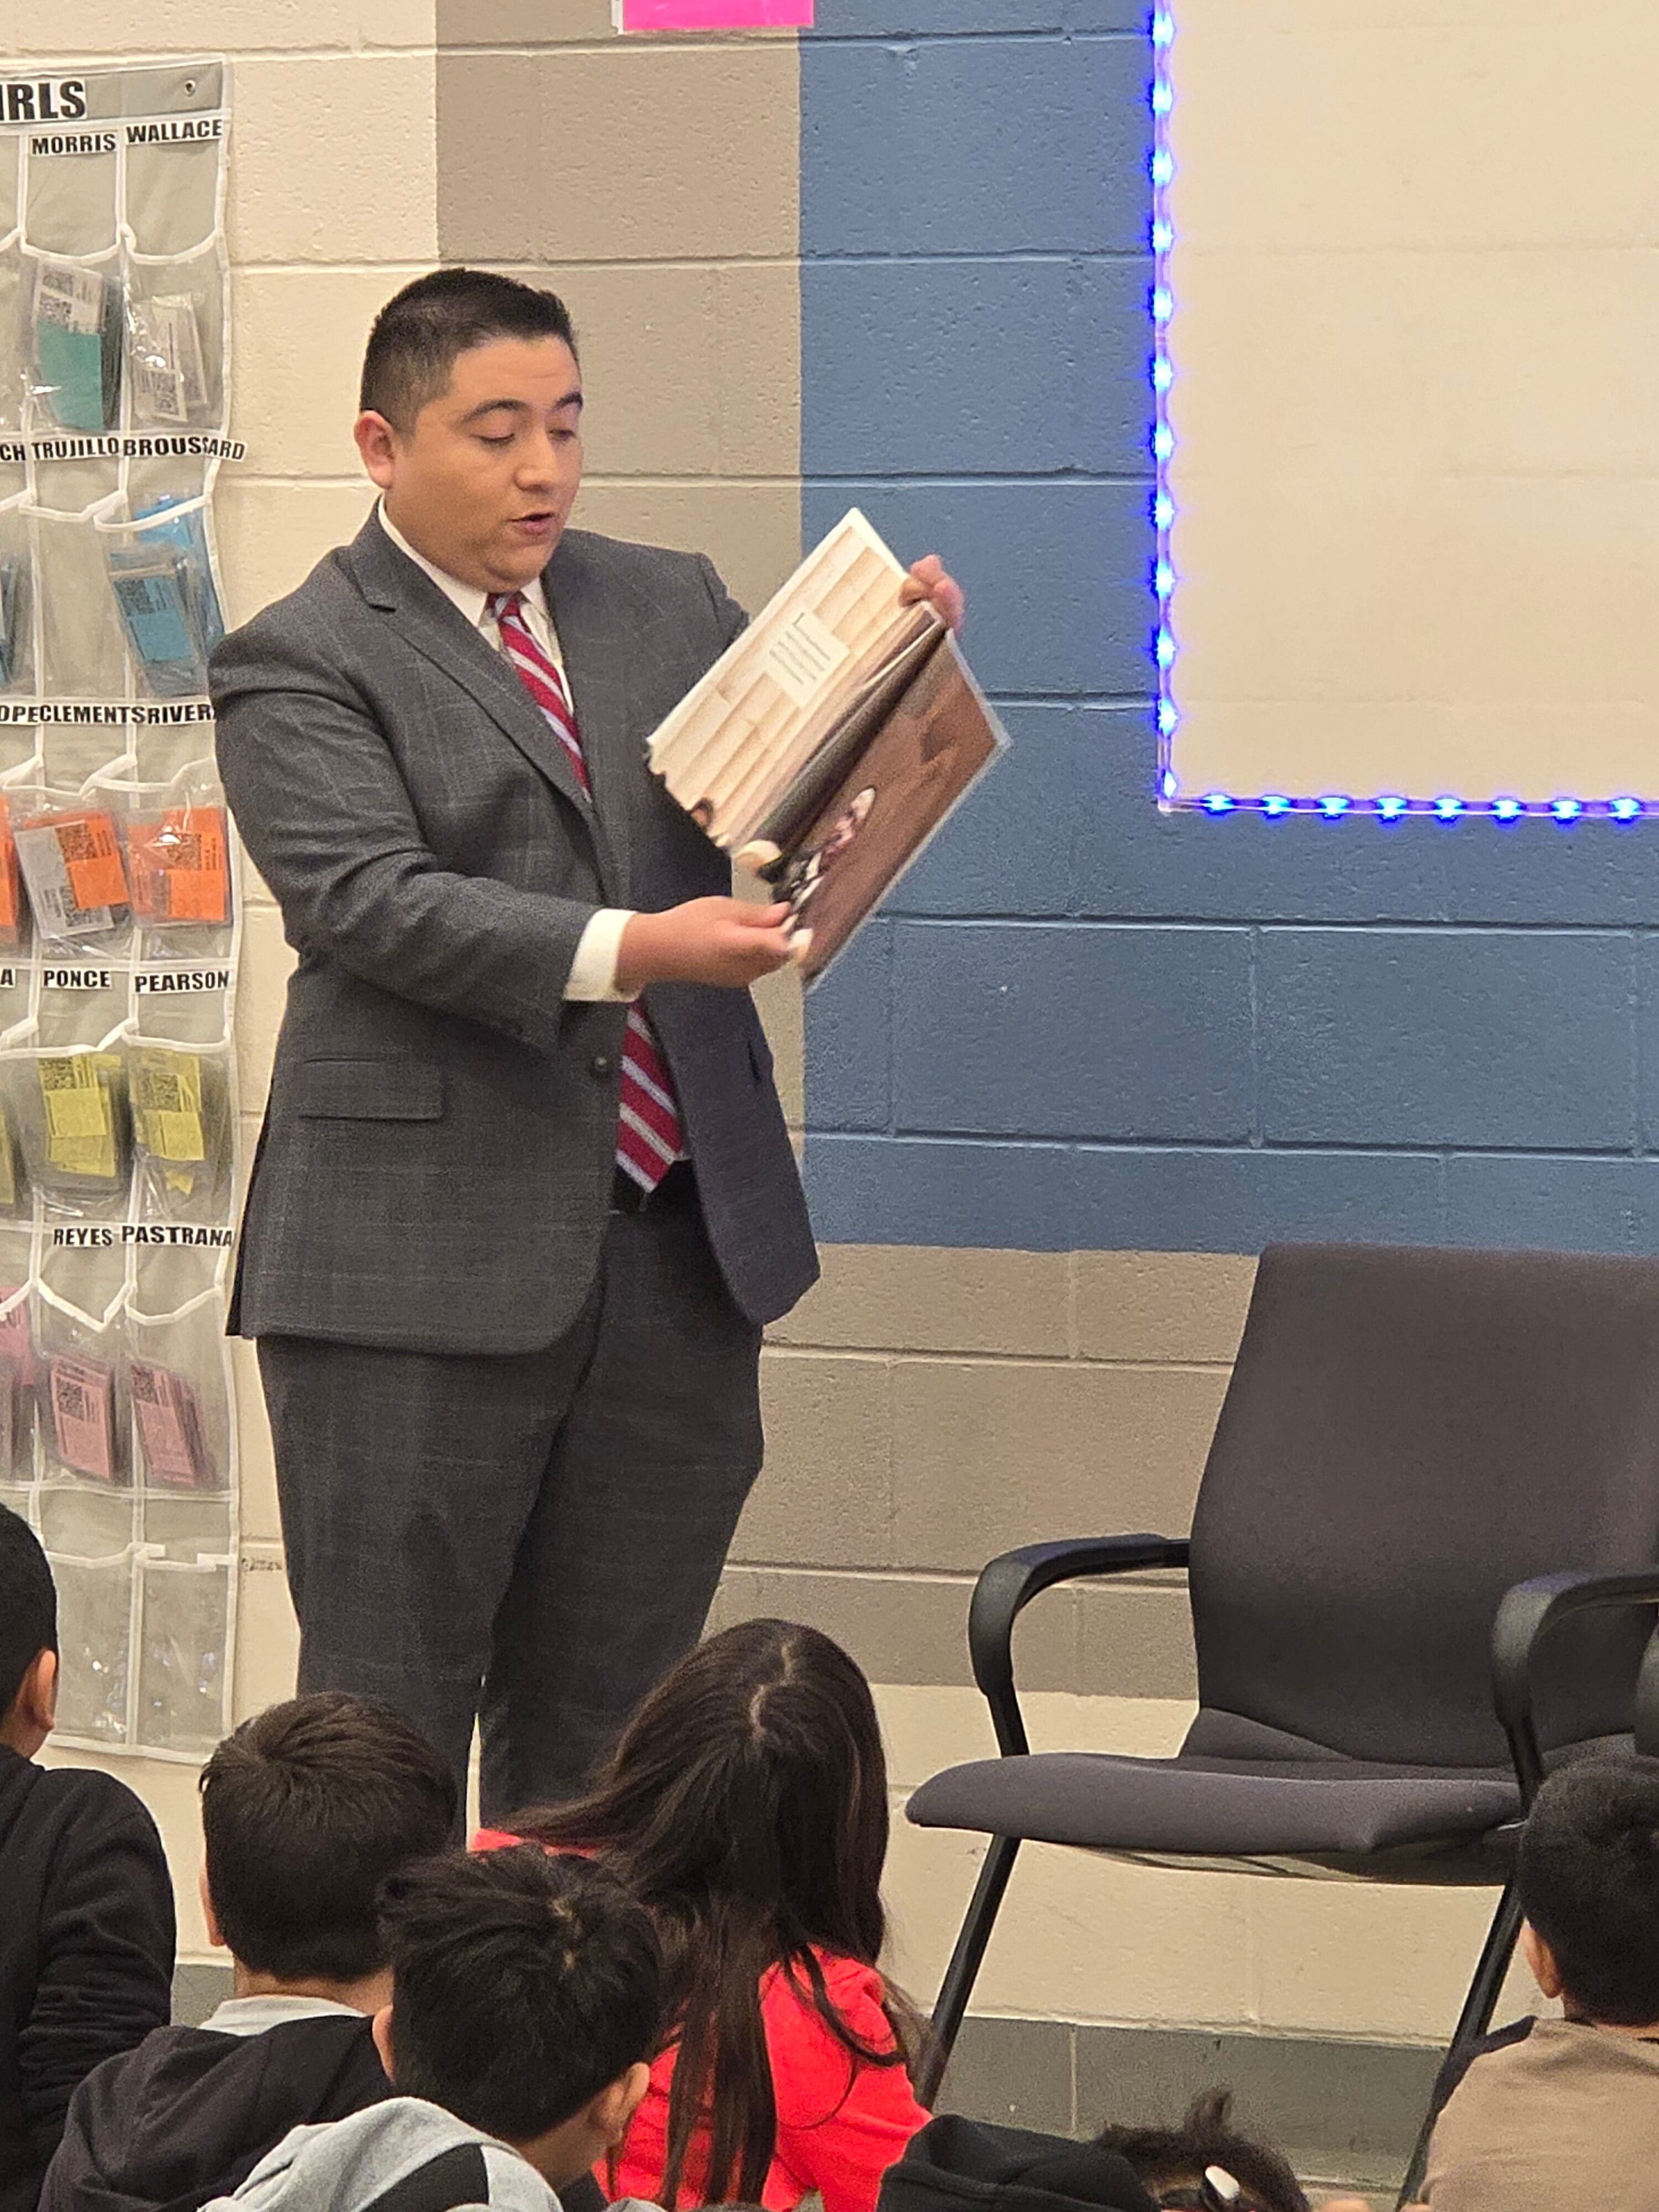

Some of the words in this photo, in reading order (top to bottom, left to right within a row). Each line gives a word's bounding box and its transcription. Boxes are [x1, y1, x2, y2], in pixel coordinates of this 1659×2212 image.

[127, 119, 222, 143] WALLACE
[32, 134, 116, 154] MORRIS
[0, 444, 26, 461] CH
[32, 437, 119, 459] TRUJILLO
[124, 437, 245, 460] BROUSSARD
[0, 705, 38, 722] OPE
[40, 705, 145, 723] CLEMENTS
[148, 704, 216, 723] RIVER
[44, 970, 110, 987] PONCE
[135, 972, 229, 992] PEARSON
[54, 1228, 112, 1246] REYES
[122, 1226, 232, 1245] PASTRANA
